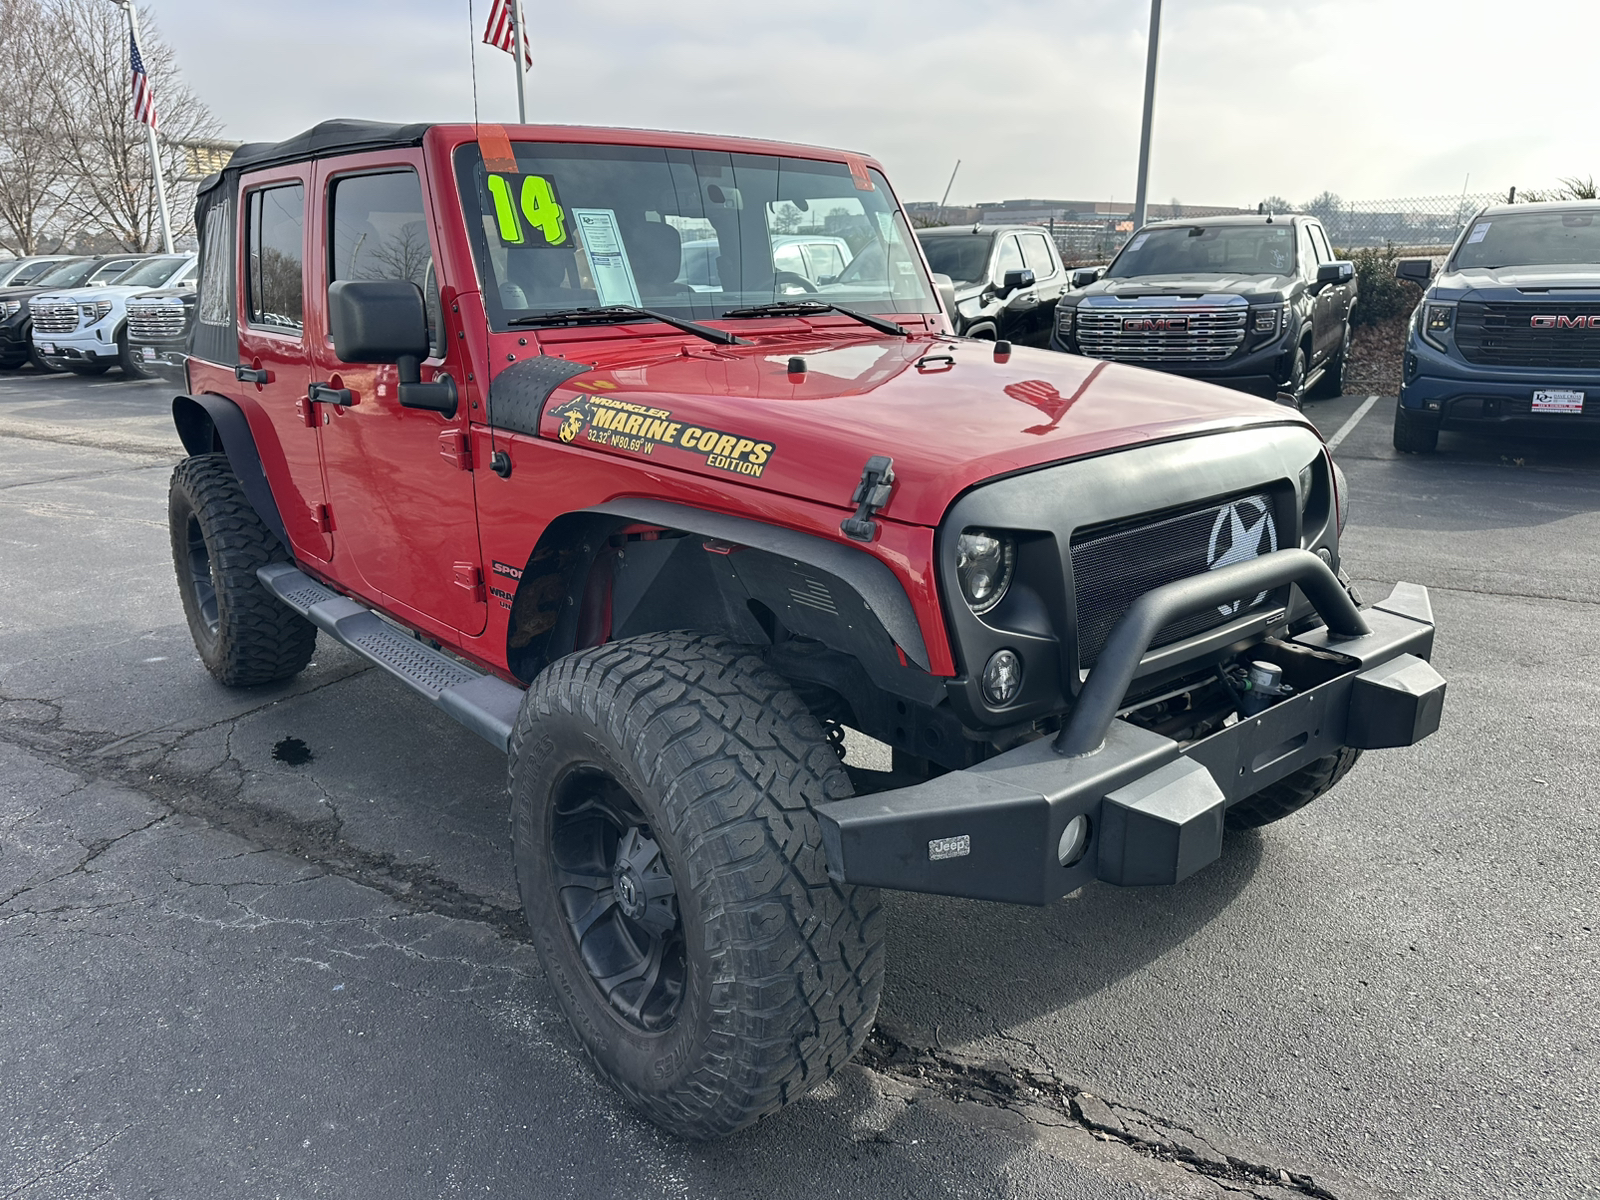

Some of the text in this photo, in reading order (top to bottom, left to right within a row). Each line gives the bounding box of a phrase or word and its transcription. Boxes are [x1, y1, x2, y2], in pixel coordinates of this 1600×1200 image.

[488, 174, 567, 246] 14
[1124, 319, 1186, 331] GMC
[590, 395, 670, 420] WRANGLER
[591, 407, 772, 464] MARINE CORPS
[644, 442, 654, 454] W
[707, 453, 763, 477] EDITION
[518, 734, 555, 850] TBB TIRES
[935, 841, 965, 853] Jeep
